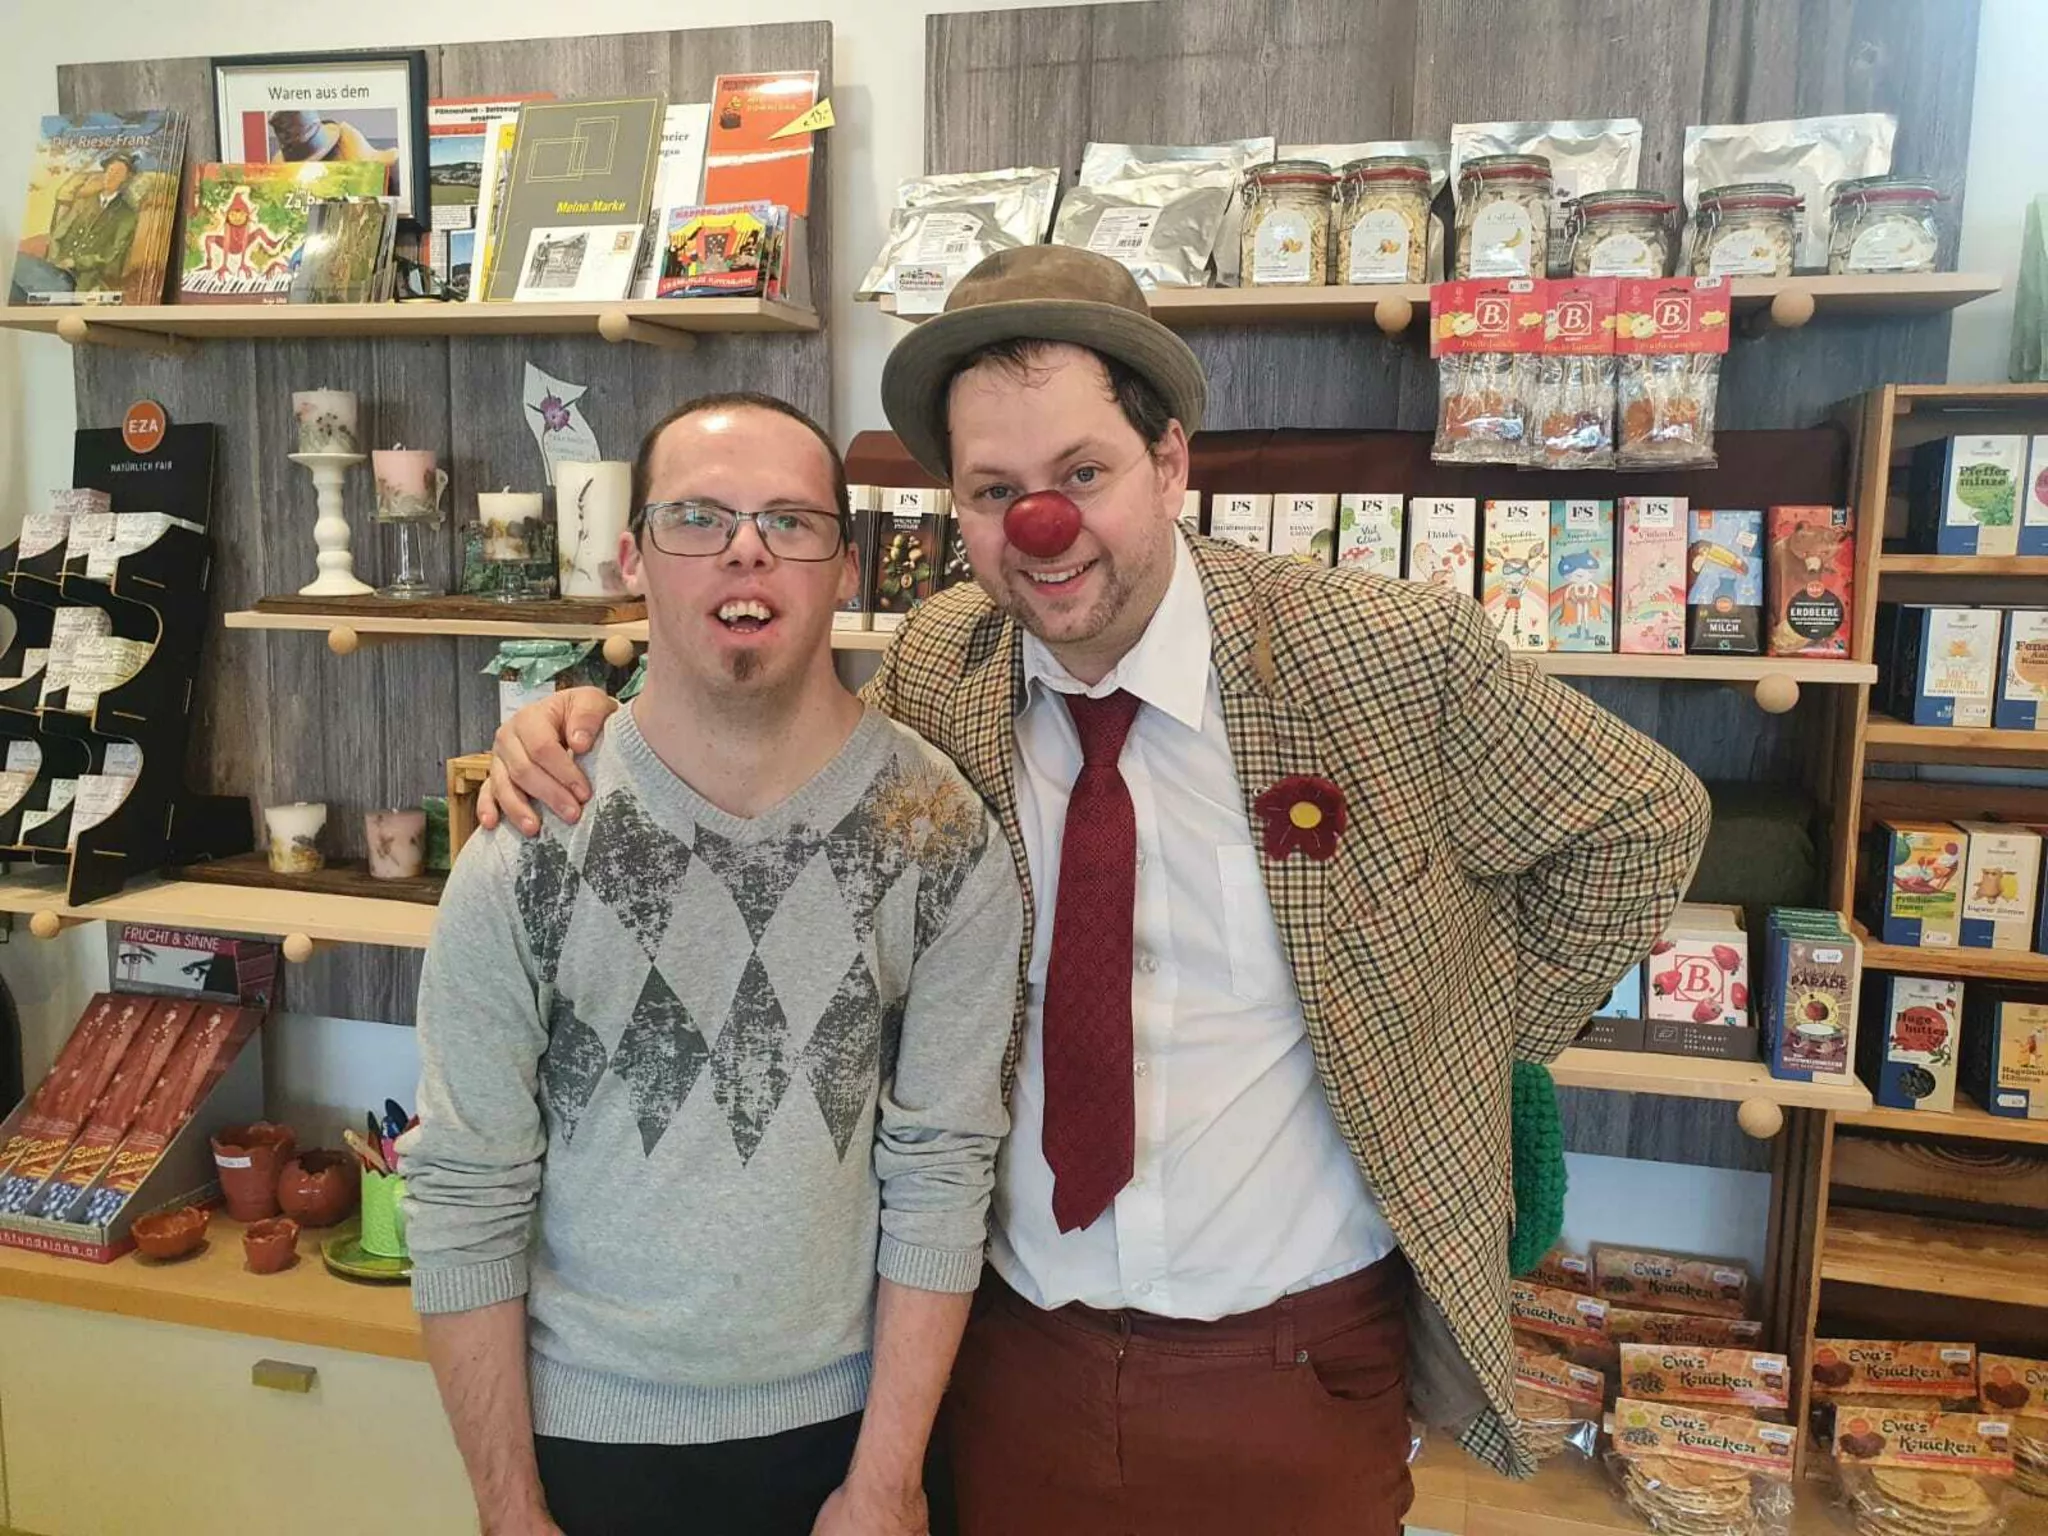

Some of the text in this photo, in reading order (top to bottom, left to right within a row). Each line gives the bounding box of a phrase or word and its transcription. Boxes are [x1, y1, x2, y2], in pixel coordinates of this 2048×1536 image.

[268, 85, 370, 100] Waren aus dem
[78, 136, 112, 147] Riese
[116, 134, 152, 146] Franz
[557, 199, 626, 214] Meine Marke
[1483, 304, 1503, 325] B.
[1564, 307, 1586, 329] B.
[1661, 304, 1684, 327] B.
[128, 418, 159, 434] EZA
[110, 460, 173, 472] NATÜRLICH FAIR
[1959, 465, 2010, 477] Pfeffer
[1960, 478, 2006, 487] minze
[1790, 607, 1839, 617] ERDBEERE
[1709, 623, 1739, 632] MILCH
[124, 926, 219, 951] FRUCHT & SINNE
[1687, 964, 1715, 993] B.
[1791, 974, 1847, 991] PARADE
[1897, 1012, 1932, 1025] Hage
[1905, 1023, 1949, 1036] butten
[1662, 1355, 1705, 1370] Eva's
[1849, 1350, 1892, 1363] Eva's
[1660, 1415, 1706, 1432] Eva's
[1882, 1419, 1927, 1434] Eva's
